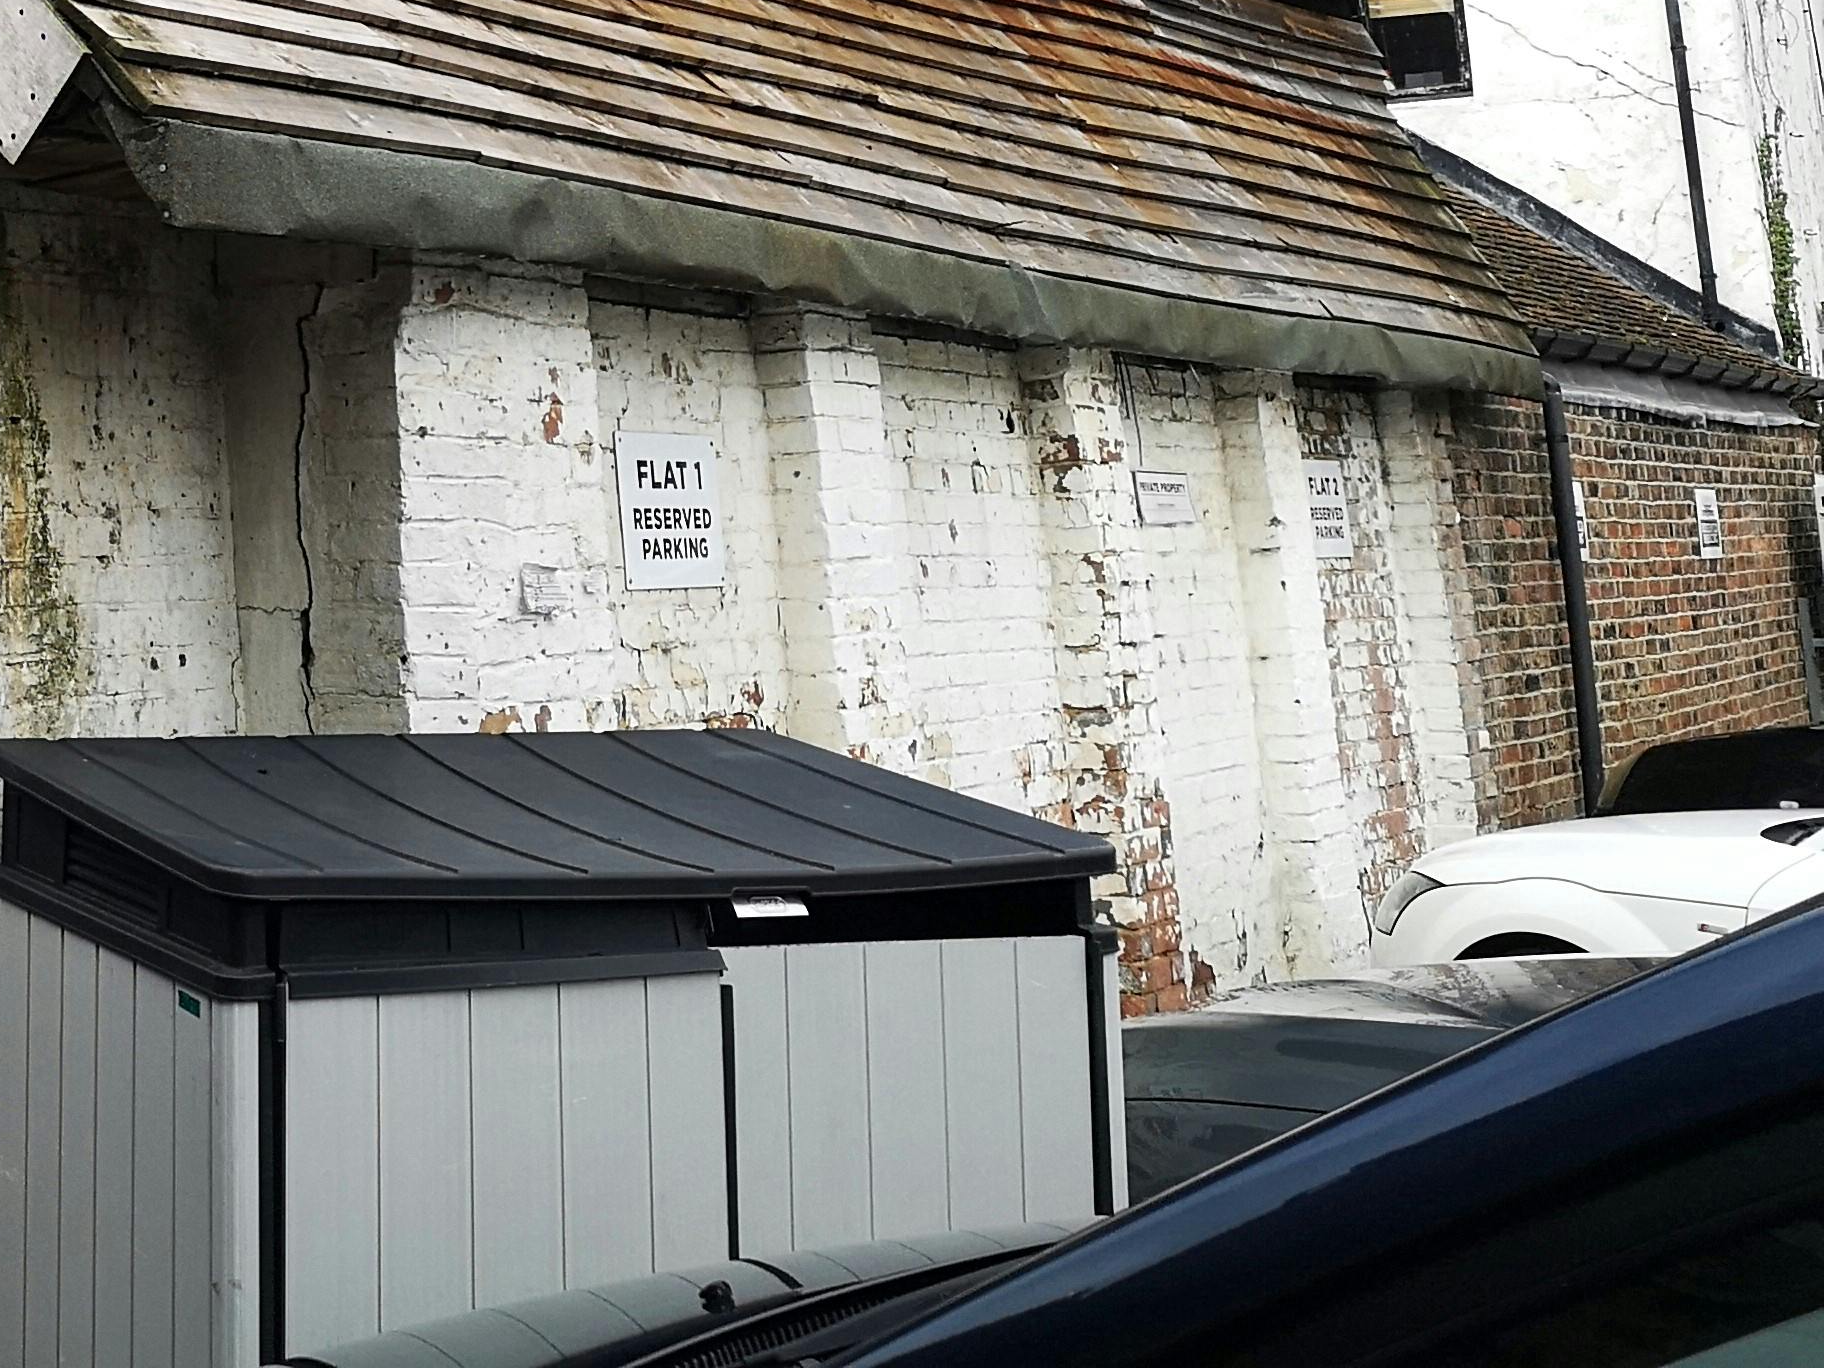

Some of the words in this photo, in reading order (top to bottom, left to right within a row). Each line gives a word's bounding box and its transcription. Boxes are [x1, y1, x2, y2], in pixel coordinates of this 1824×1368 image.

[636, 460, 687, 490] FLAT
[694, 461, 703, 490] 1
[1308, 476, 1331, 496] FLAT
[1332, 477, 1339, 496] 2
[633, 507, 712, 530] RESERVED
[1310, 507, 1344, 520] RESERVED
[1315, 525, 1344, 539] PARKING
[642, 537, 709, 560] PARKING
